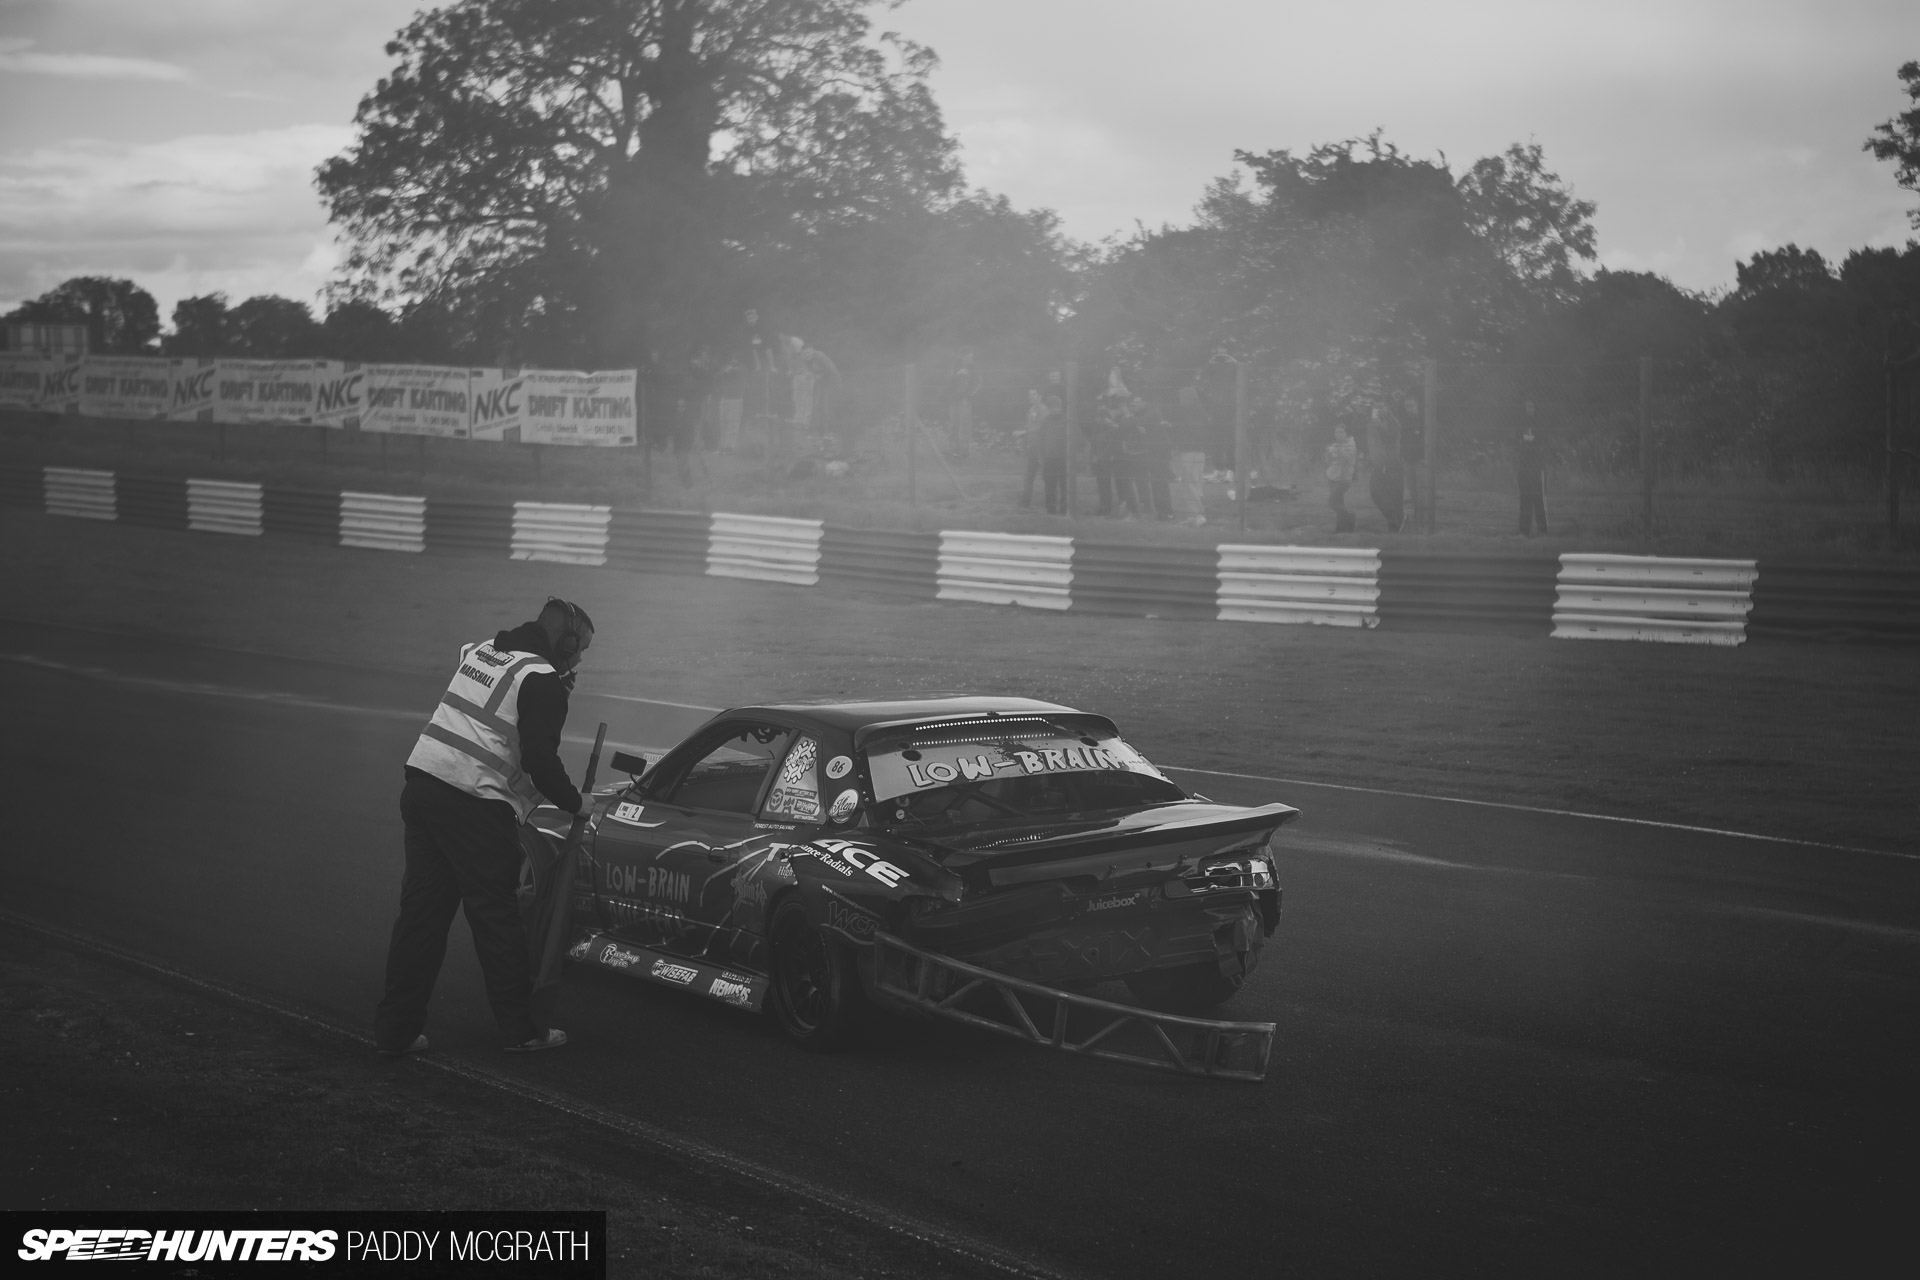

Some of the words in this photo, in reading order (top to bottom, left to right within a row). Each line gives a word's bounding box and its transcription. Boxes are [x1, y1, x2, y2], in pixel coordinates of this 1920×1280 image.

[43, 365, 81, 400] NKC
[173, 369, 216, 407] NKC
[220, 380, 254, 401] DRIFT
[258, 382, 313, 402] KARTING
[316, 374, 364, 412] NKC
[367, 386, 406, 408] DRIFT
[410, 388, 467, 413] KARTING
[474, 380, 523, 424] NKC
[528, 394, 568, 418] DRIFT
[572, 395, 632, 419] KARTING
[458, 663, 495, 689] MARSHALL
[831, 760, 846, 774] 86
[906, 746, 1122, 788] LOW-BRAIN
[631, 806, 640, 819] 2
[819, 852, 854, 877] Radials
[606, 862, 691, 904] LOW-BRAIN
[1086, 896, 1136, 912] Juicebox
[606, 944, 641, 965] Racing
[660, 965, 698, 983] WISEFAB
[708, 978, 753, 1002] NEMISIS
